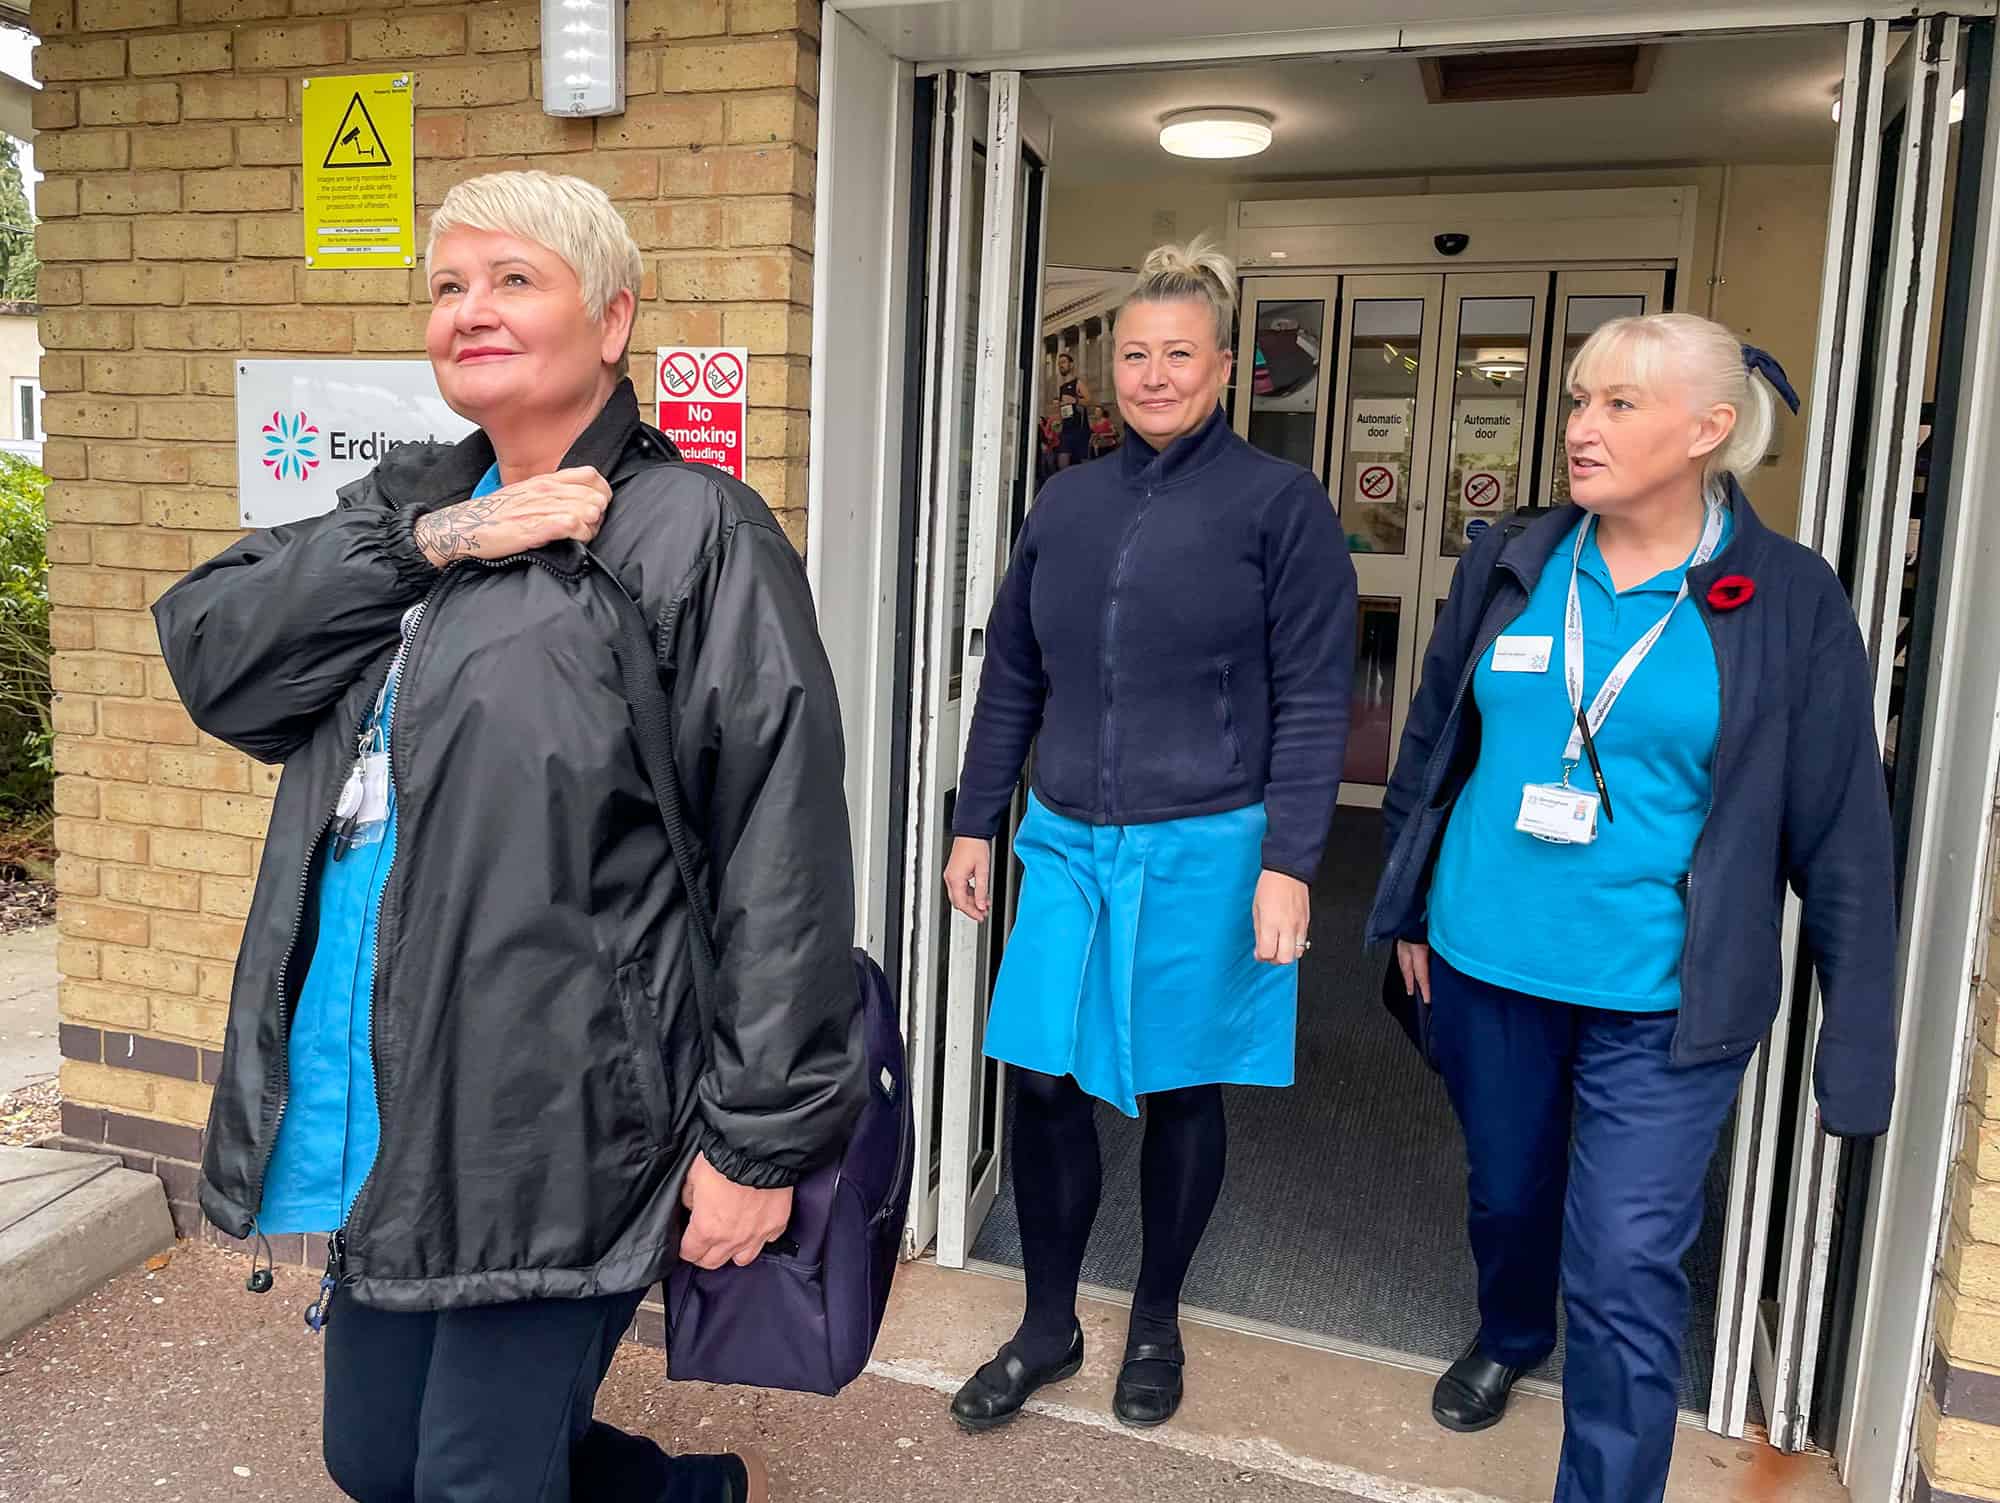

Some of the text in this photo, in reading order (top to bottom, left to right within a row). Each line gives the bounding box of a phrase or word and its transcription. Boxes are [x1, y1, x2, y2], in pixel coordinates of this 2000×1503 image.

[687, 404, 713, 422] No
[1356, 413, 1402, 425] Automatic
[1463, 413, 1511, 426] Automatic
[665, 425, 737, 448] smoking
[1367, 426, 1389, 438] door
[1474, 427, 1497, 439] door
[679, 447, 726, 463] ncluding
